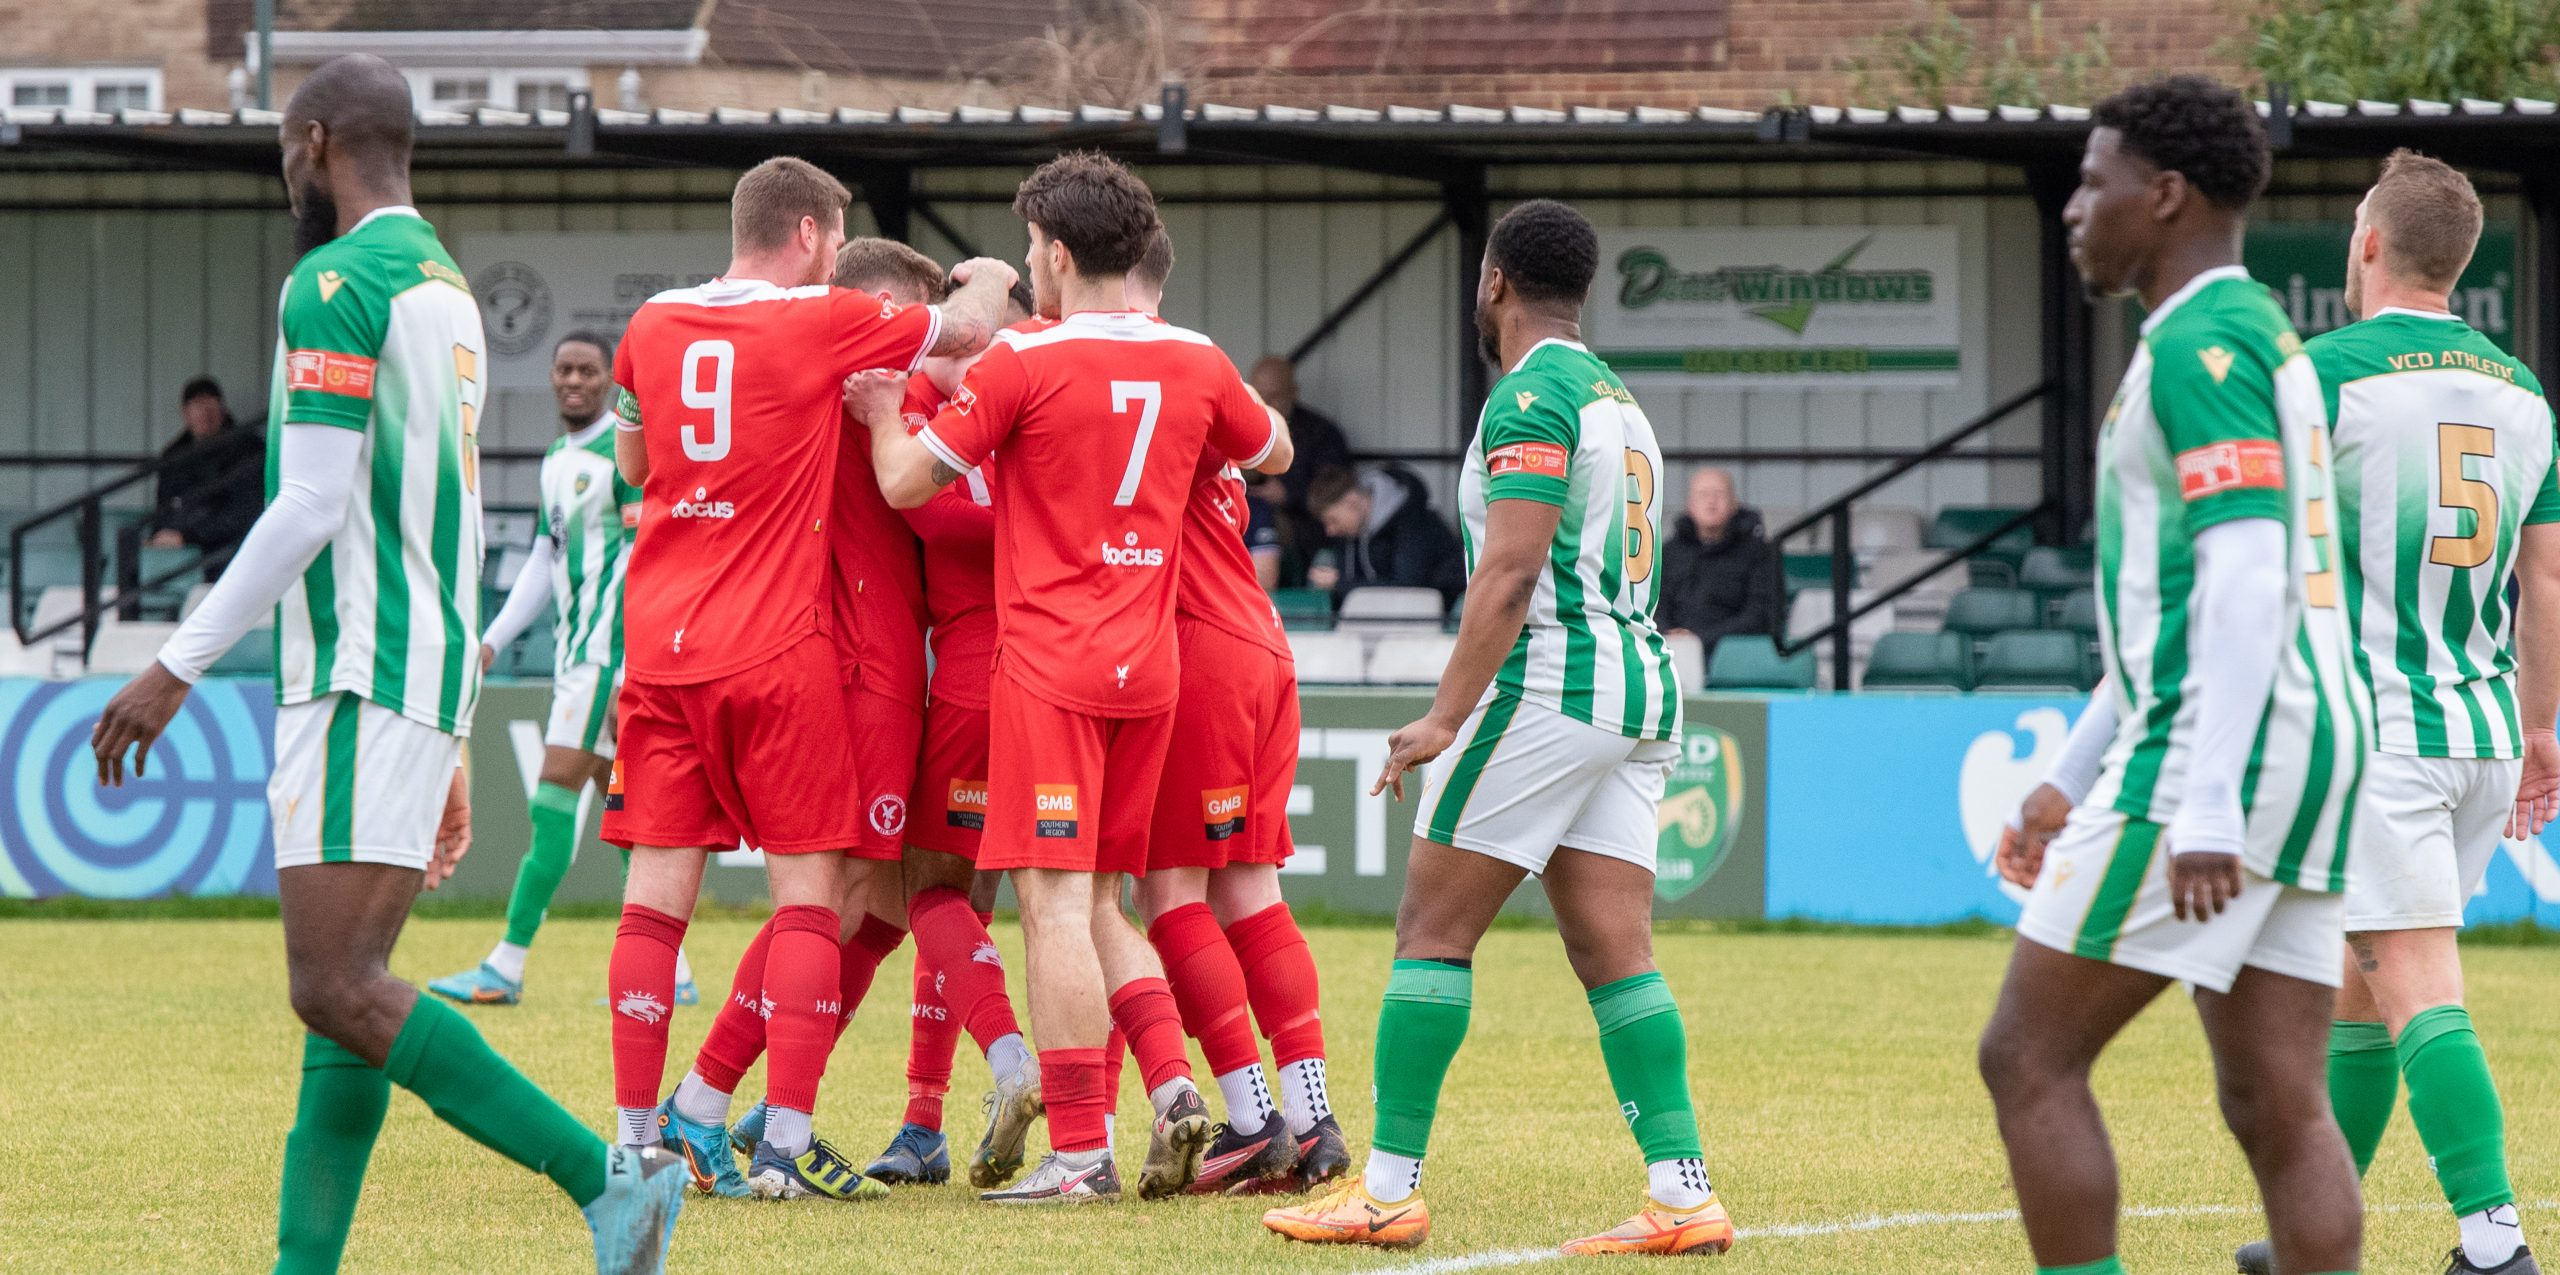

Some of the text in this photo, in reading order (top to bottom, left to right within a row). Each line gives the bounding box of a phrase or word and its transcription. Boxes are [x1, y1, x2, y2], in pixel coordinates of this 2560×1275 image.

[2387, 350, 2515, 382] VCD ATHLETIC
[681, 339, 735, 462] 9
[1110, 380, 1162, 506] 7
[2429, 422, 2499, 569] 5
[1102, 541, 1163, 567] focus
[1036, 794, 1073, 811] GMB
[1208, 794, 1242, 815] GMB
[1040, 820, 1070, 829] SOUTHERN
[1045, 829, 1066, 837] REGION
